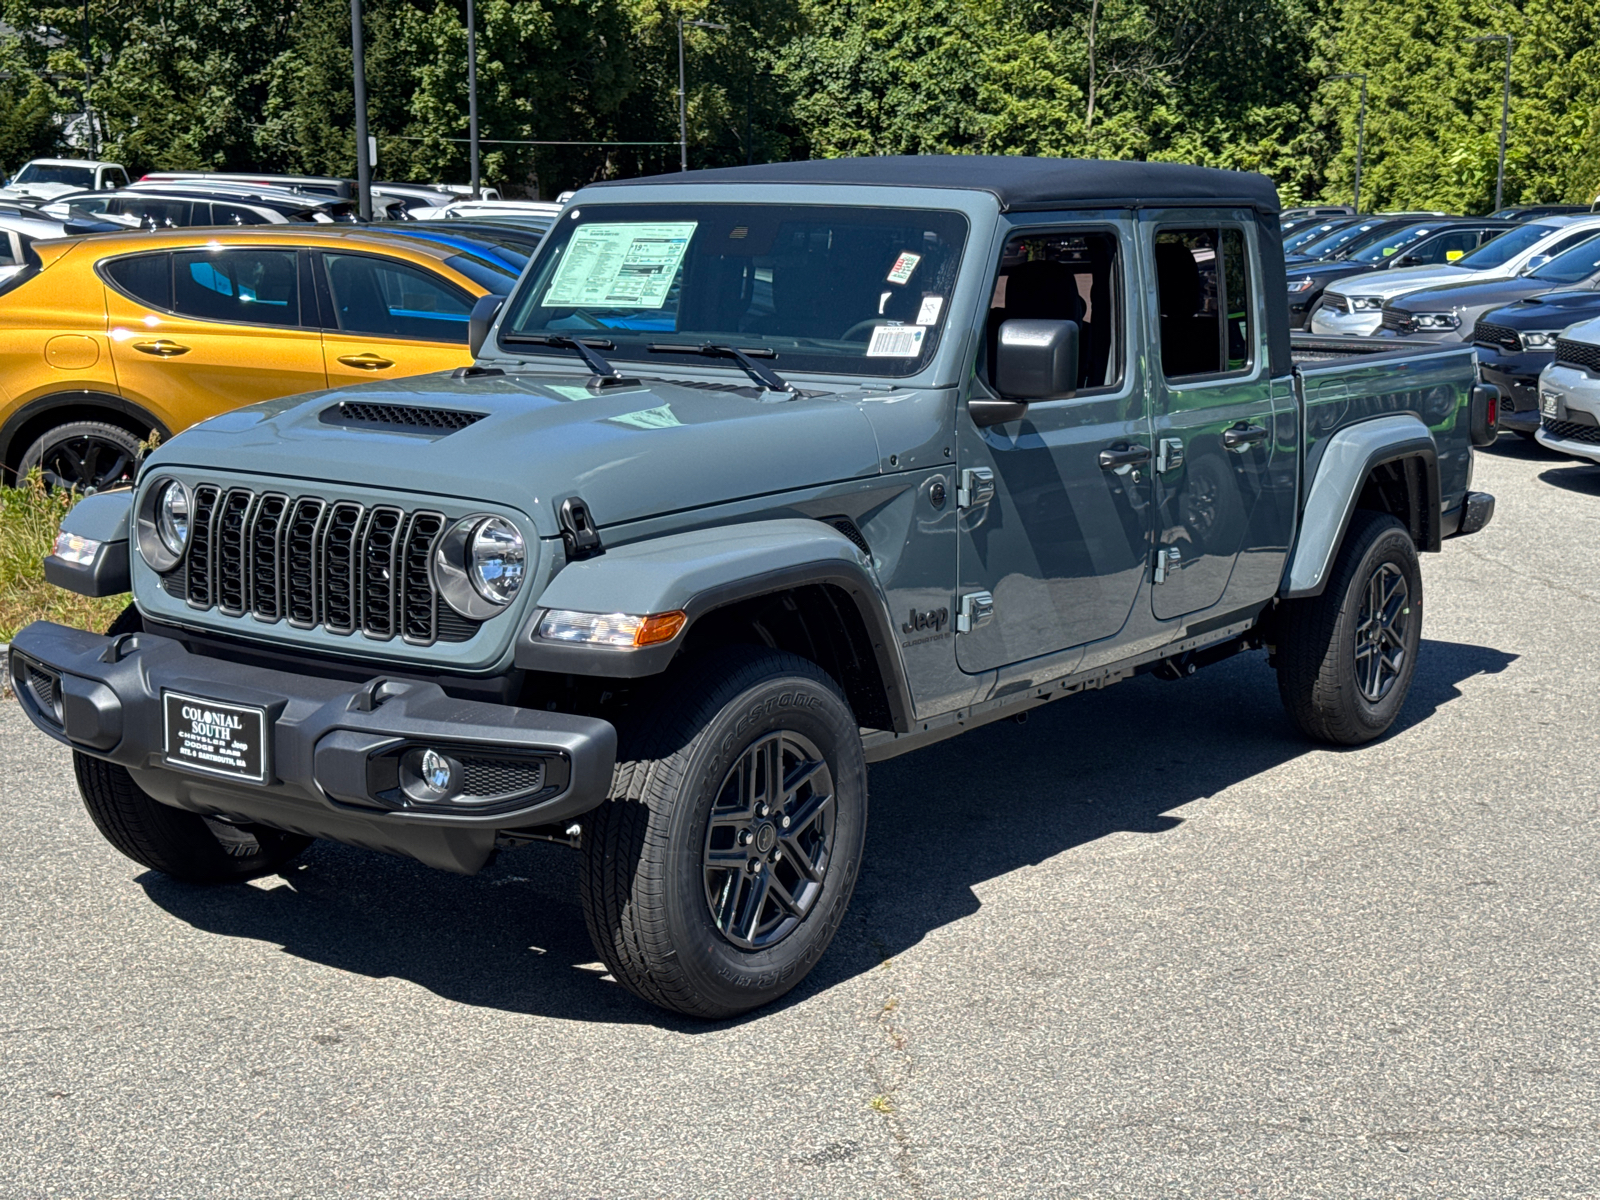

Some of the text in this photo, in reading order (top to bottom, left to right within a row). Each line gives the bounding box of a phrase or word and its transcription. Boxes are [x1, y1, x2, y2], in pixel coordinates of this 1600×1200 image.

[901, 606, 949, 635] Jeep
[901, 633, 944, 648] GLADIATOR
[182, 706, 242, 729] COLONIAL
[192, 720, 231, 740] SOUTH
[178, 731, 248, 751] CHRYSLER Jeep
[184, 740, 214, 752] DODGE
[689, 691, 822, 849] BRIDGESTONE
[758, 861, 855, 989] DUELER
